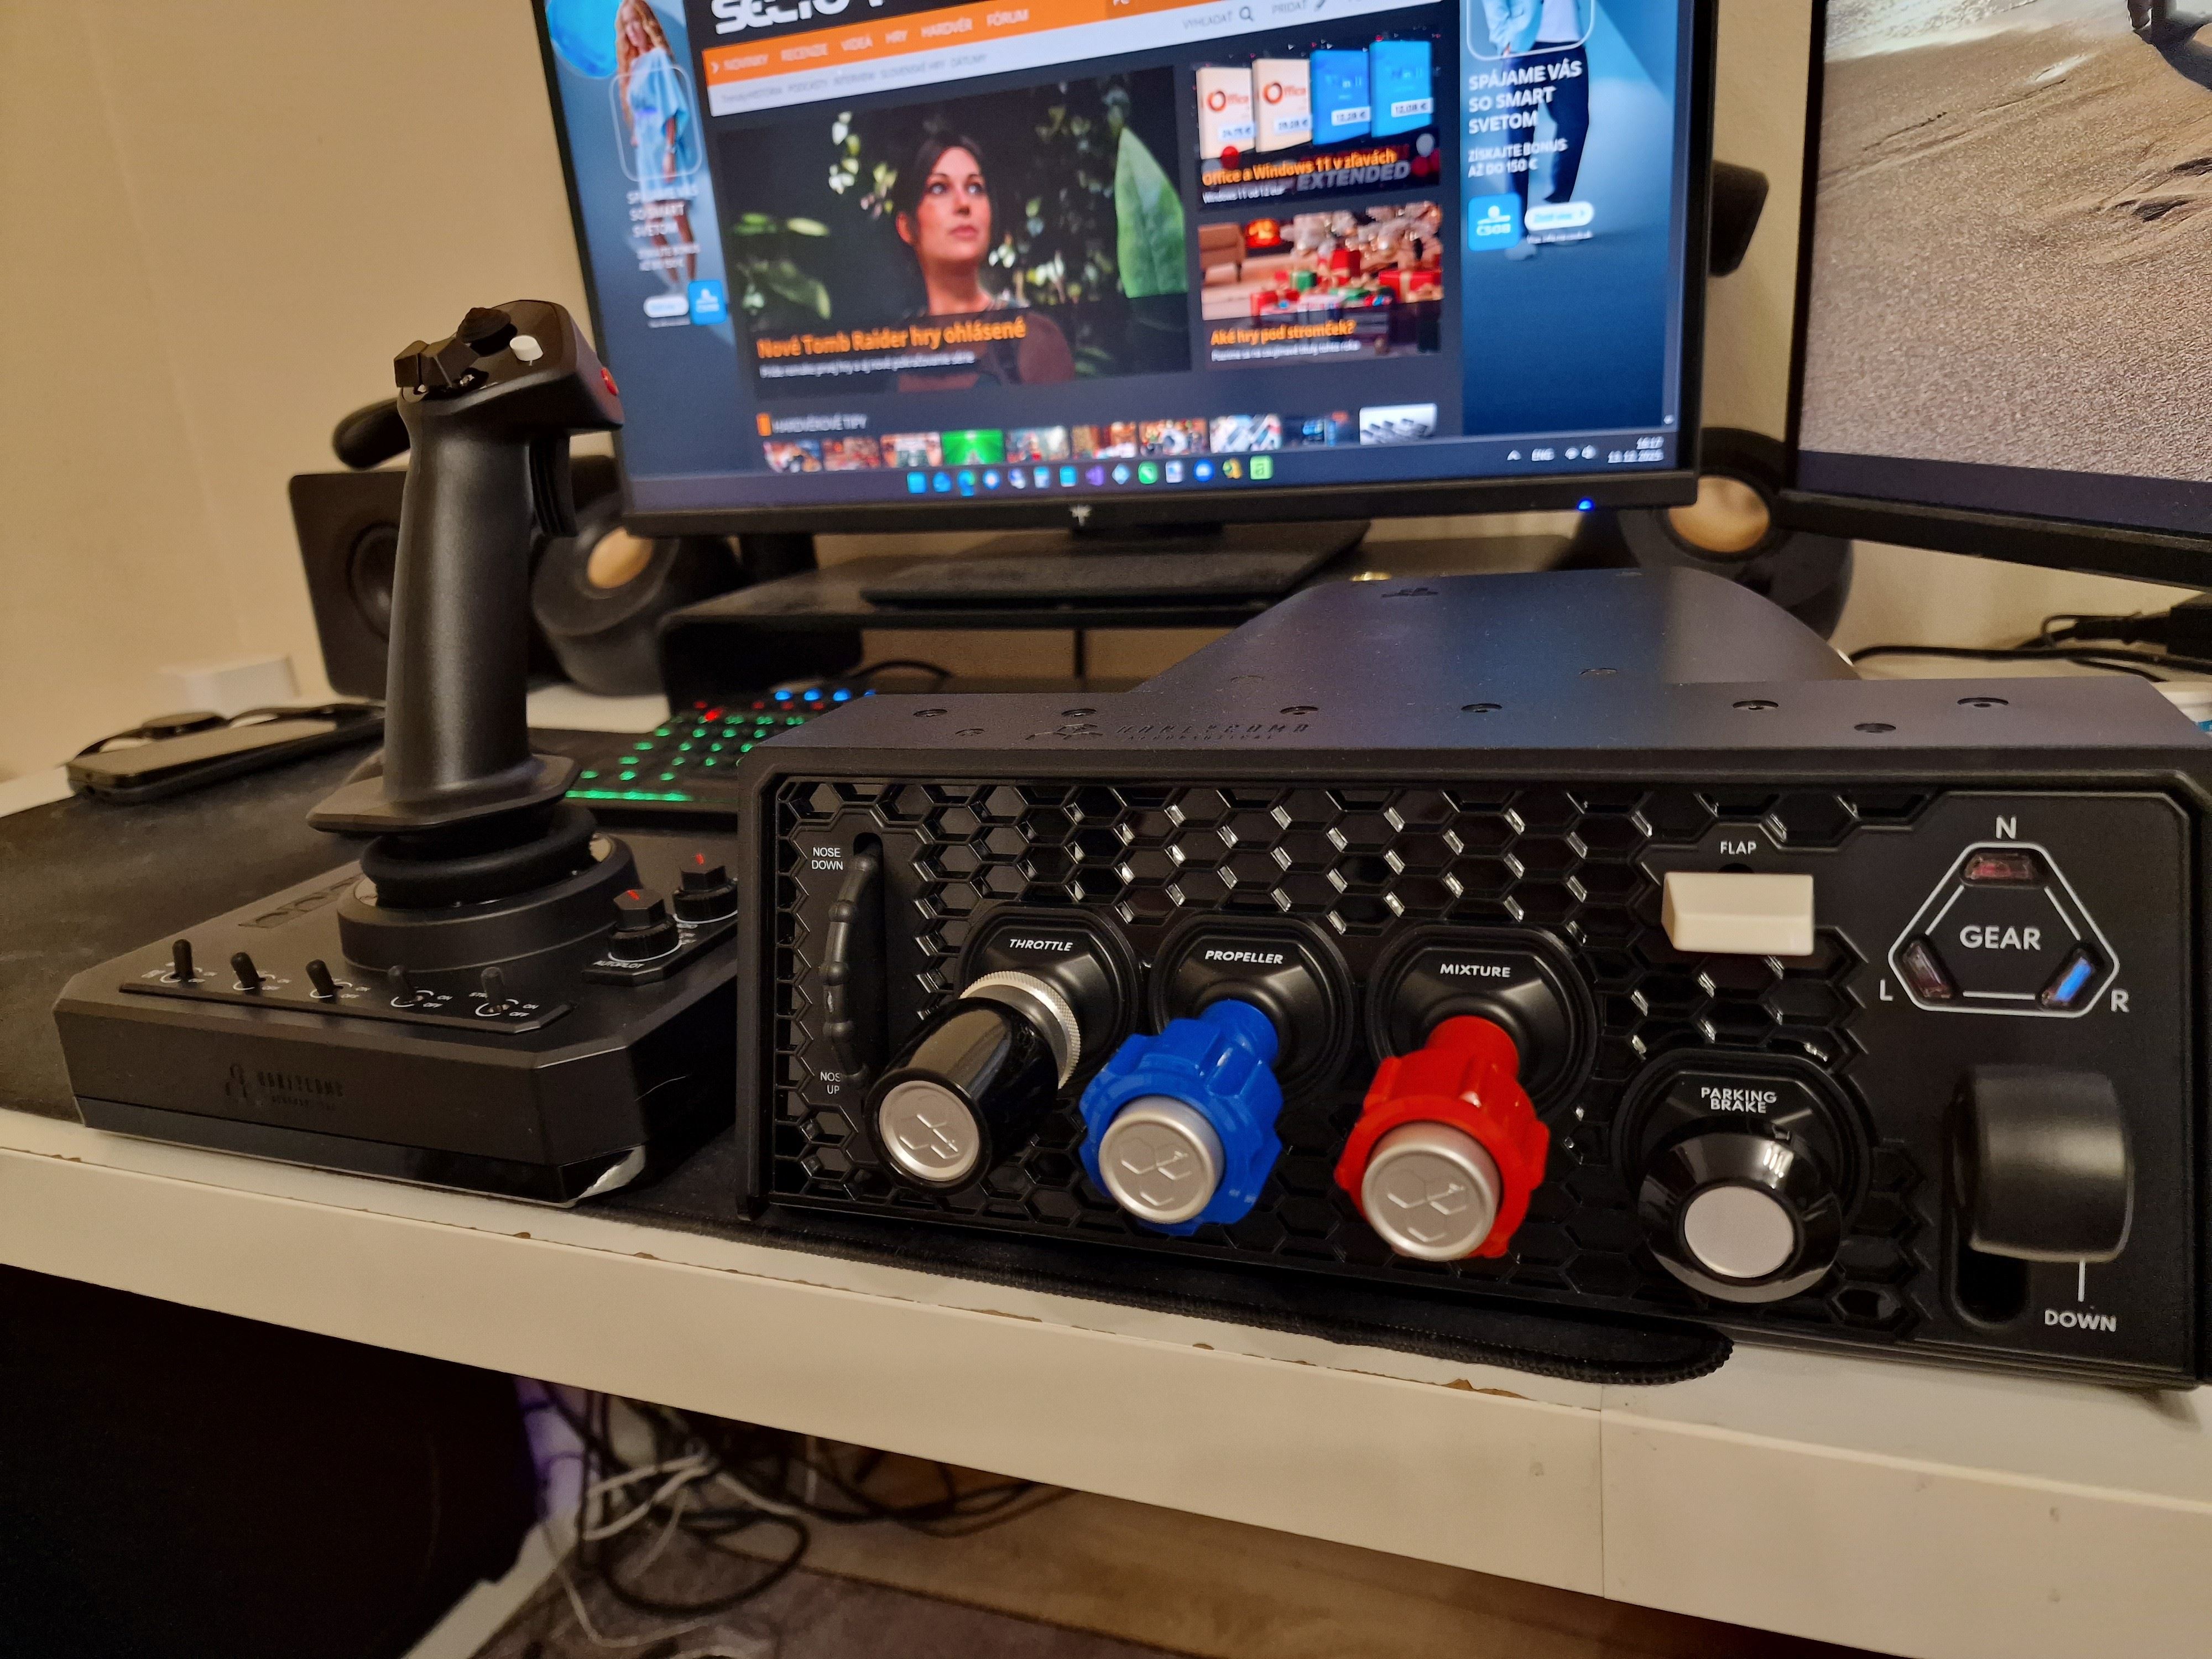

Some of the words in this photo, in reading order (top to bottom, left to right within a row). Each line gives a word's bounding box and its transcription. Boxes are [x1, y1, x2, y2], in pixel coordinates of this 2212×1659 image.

[987, 8, 1030, 27] FÓRUM
[1469, 67, 1546, 91] SPÁJAME
[1547, 58, 1582, 81] VÁS
[1469, 96, 1491, 113] SO
[1496, 86, 1557, 109] SMART
[1468, 110, 1538, 134] SVETOM
[1523, 138, 1568, 156] BONUS
[1202, 170, 1242, 186] Office
[1243, 169, 1253, 181] a
[1253, 159, 1314, 180] Windows
[1315, 156, 1328, 171] 11
[1296, 160, 1412, 191] EXTENDED
[1486, 161, 1505, 175] DO
[1506, 159, 1526, 173] 150
[1528, 159, 1538, 171] €
[757, 335, 800, 358] Nové
[801, 332, 850, 354] Tomb
[852, 328, 908, 351] Raider
[910, 324, 942, 349] hry
[943, 315, 1026, 343] ohlásené
[1211, 327, 1236, 346] Aké
[1237, 326, 1260, 346] hry
[1261, 323, 1287, 345] pod
[1995, 815, 2017, 839] N
[813, 847, 841, 858] NOSE
[1720, 841, 1757, 855] FLAP
[811, 860, 843, 870] DOWN
[1009, 939, 1073, 952] THROTTLE
[1959, 925, 2041, 951] GEAR
[593, 960, 645, 969] AUTOPILOT
[1204, 950, 1284, 964] PROPELLER
[1440, 963, 1511, 978] MIXTURE
[1880, 979, 1893, 1001] L
[2110, 989, 2130, 1013] R
[820, 1071, 841, 1082] NOS
[827, 1085, 840, 1094] UP
[1701, 1087, 1777, 1104] PARKING
[1710, 1098, 1766, 1114] BRAKE
[2044, 1308, 2117, 1332] DOWN
